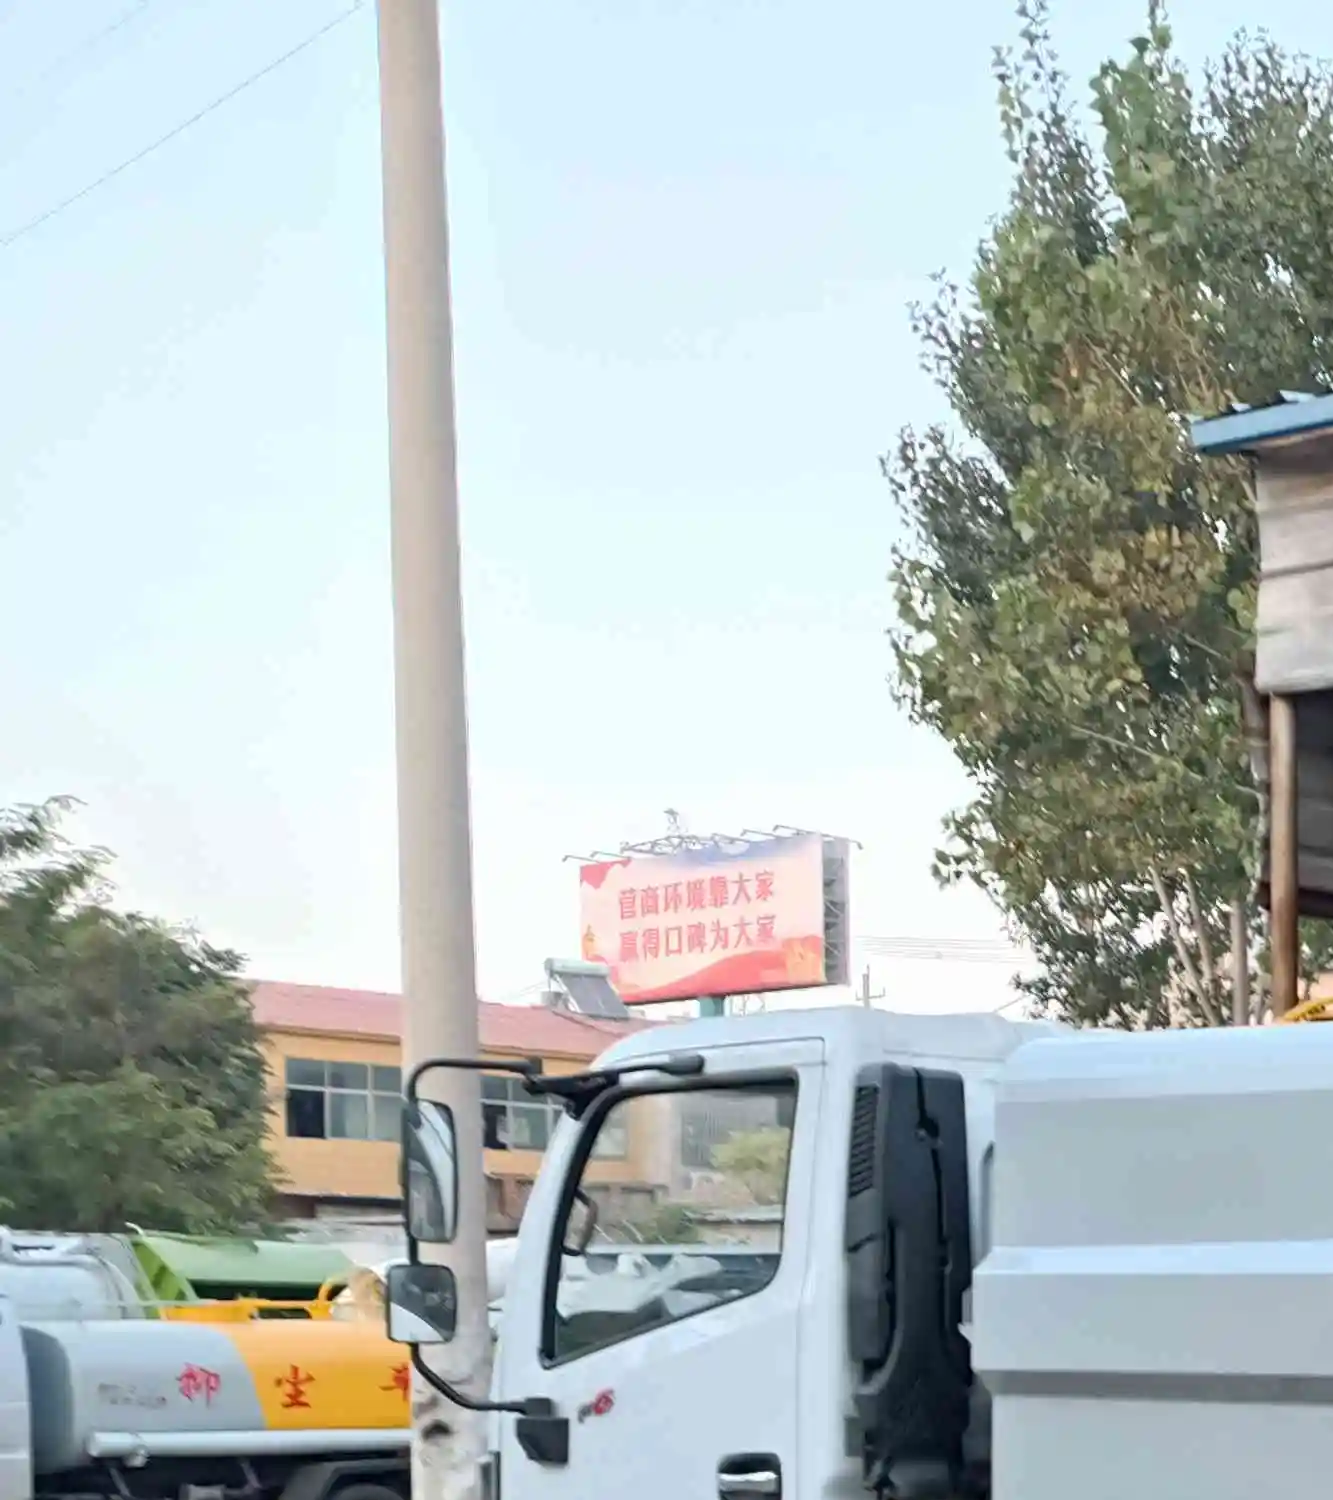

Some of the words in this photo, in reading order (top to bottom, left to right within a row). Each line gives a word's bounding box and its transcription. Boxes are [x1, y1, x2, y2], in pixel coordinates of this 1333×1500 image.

[619, 869, 775, 920] 营商环境靠大家
[619, 914, 777, 962] 赢得口碑为大家
